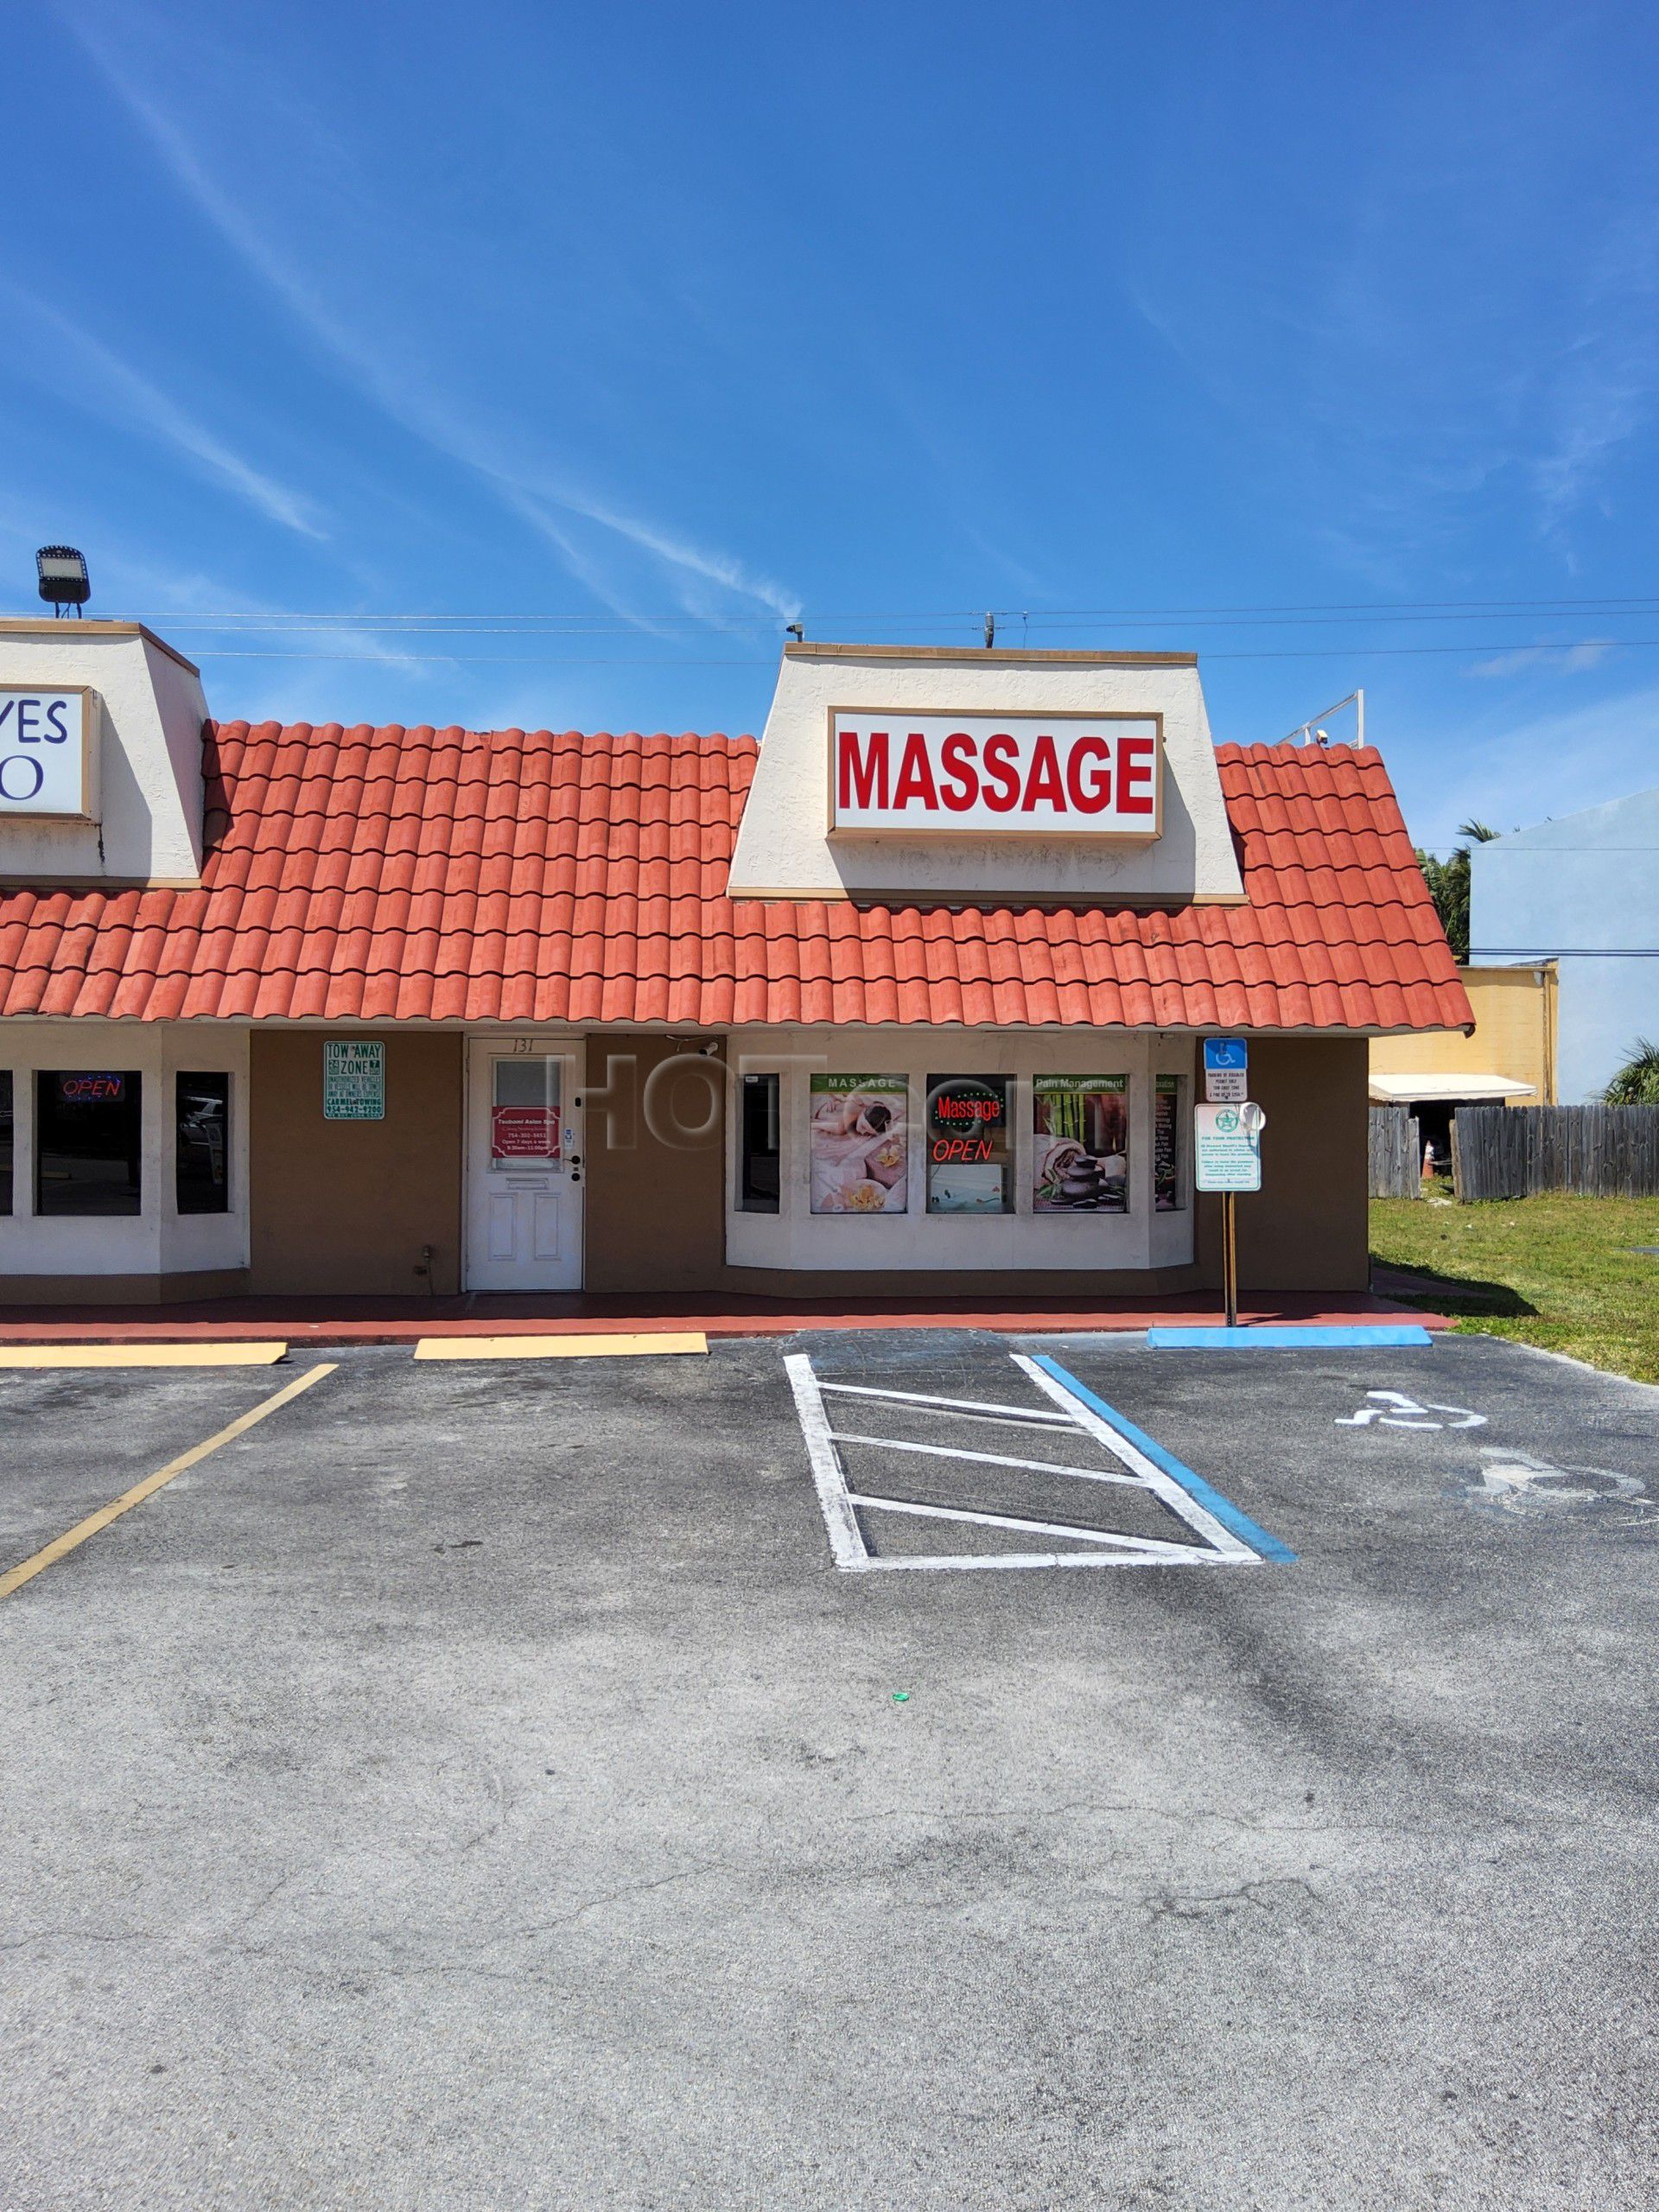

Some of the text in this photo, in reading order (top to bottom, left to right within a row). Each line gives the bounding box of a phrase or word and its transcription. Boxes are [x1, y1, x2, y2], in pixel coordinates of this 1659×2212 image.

[839, 732, 1154, 814] MASSAGE
[328, 1044, 381, 1058] TOW AWAY
[513, 1039, 534, 1053] 131
[340, 1060, 369, 1075] ZONE
[63, 1079, 121, 1096] OPEN
[828, 1078, 896, 1088] MASSAGE
[1036, 1079, 1124, 1090] Pain Management
[938, 1096, 1001, 1122] Massage
[932, 1139, 994, 1161] OPEN
